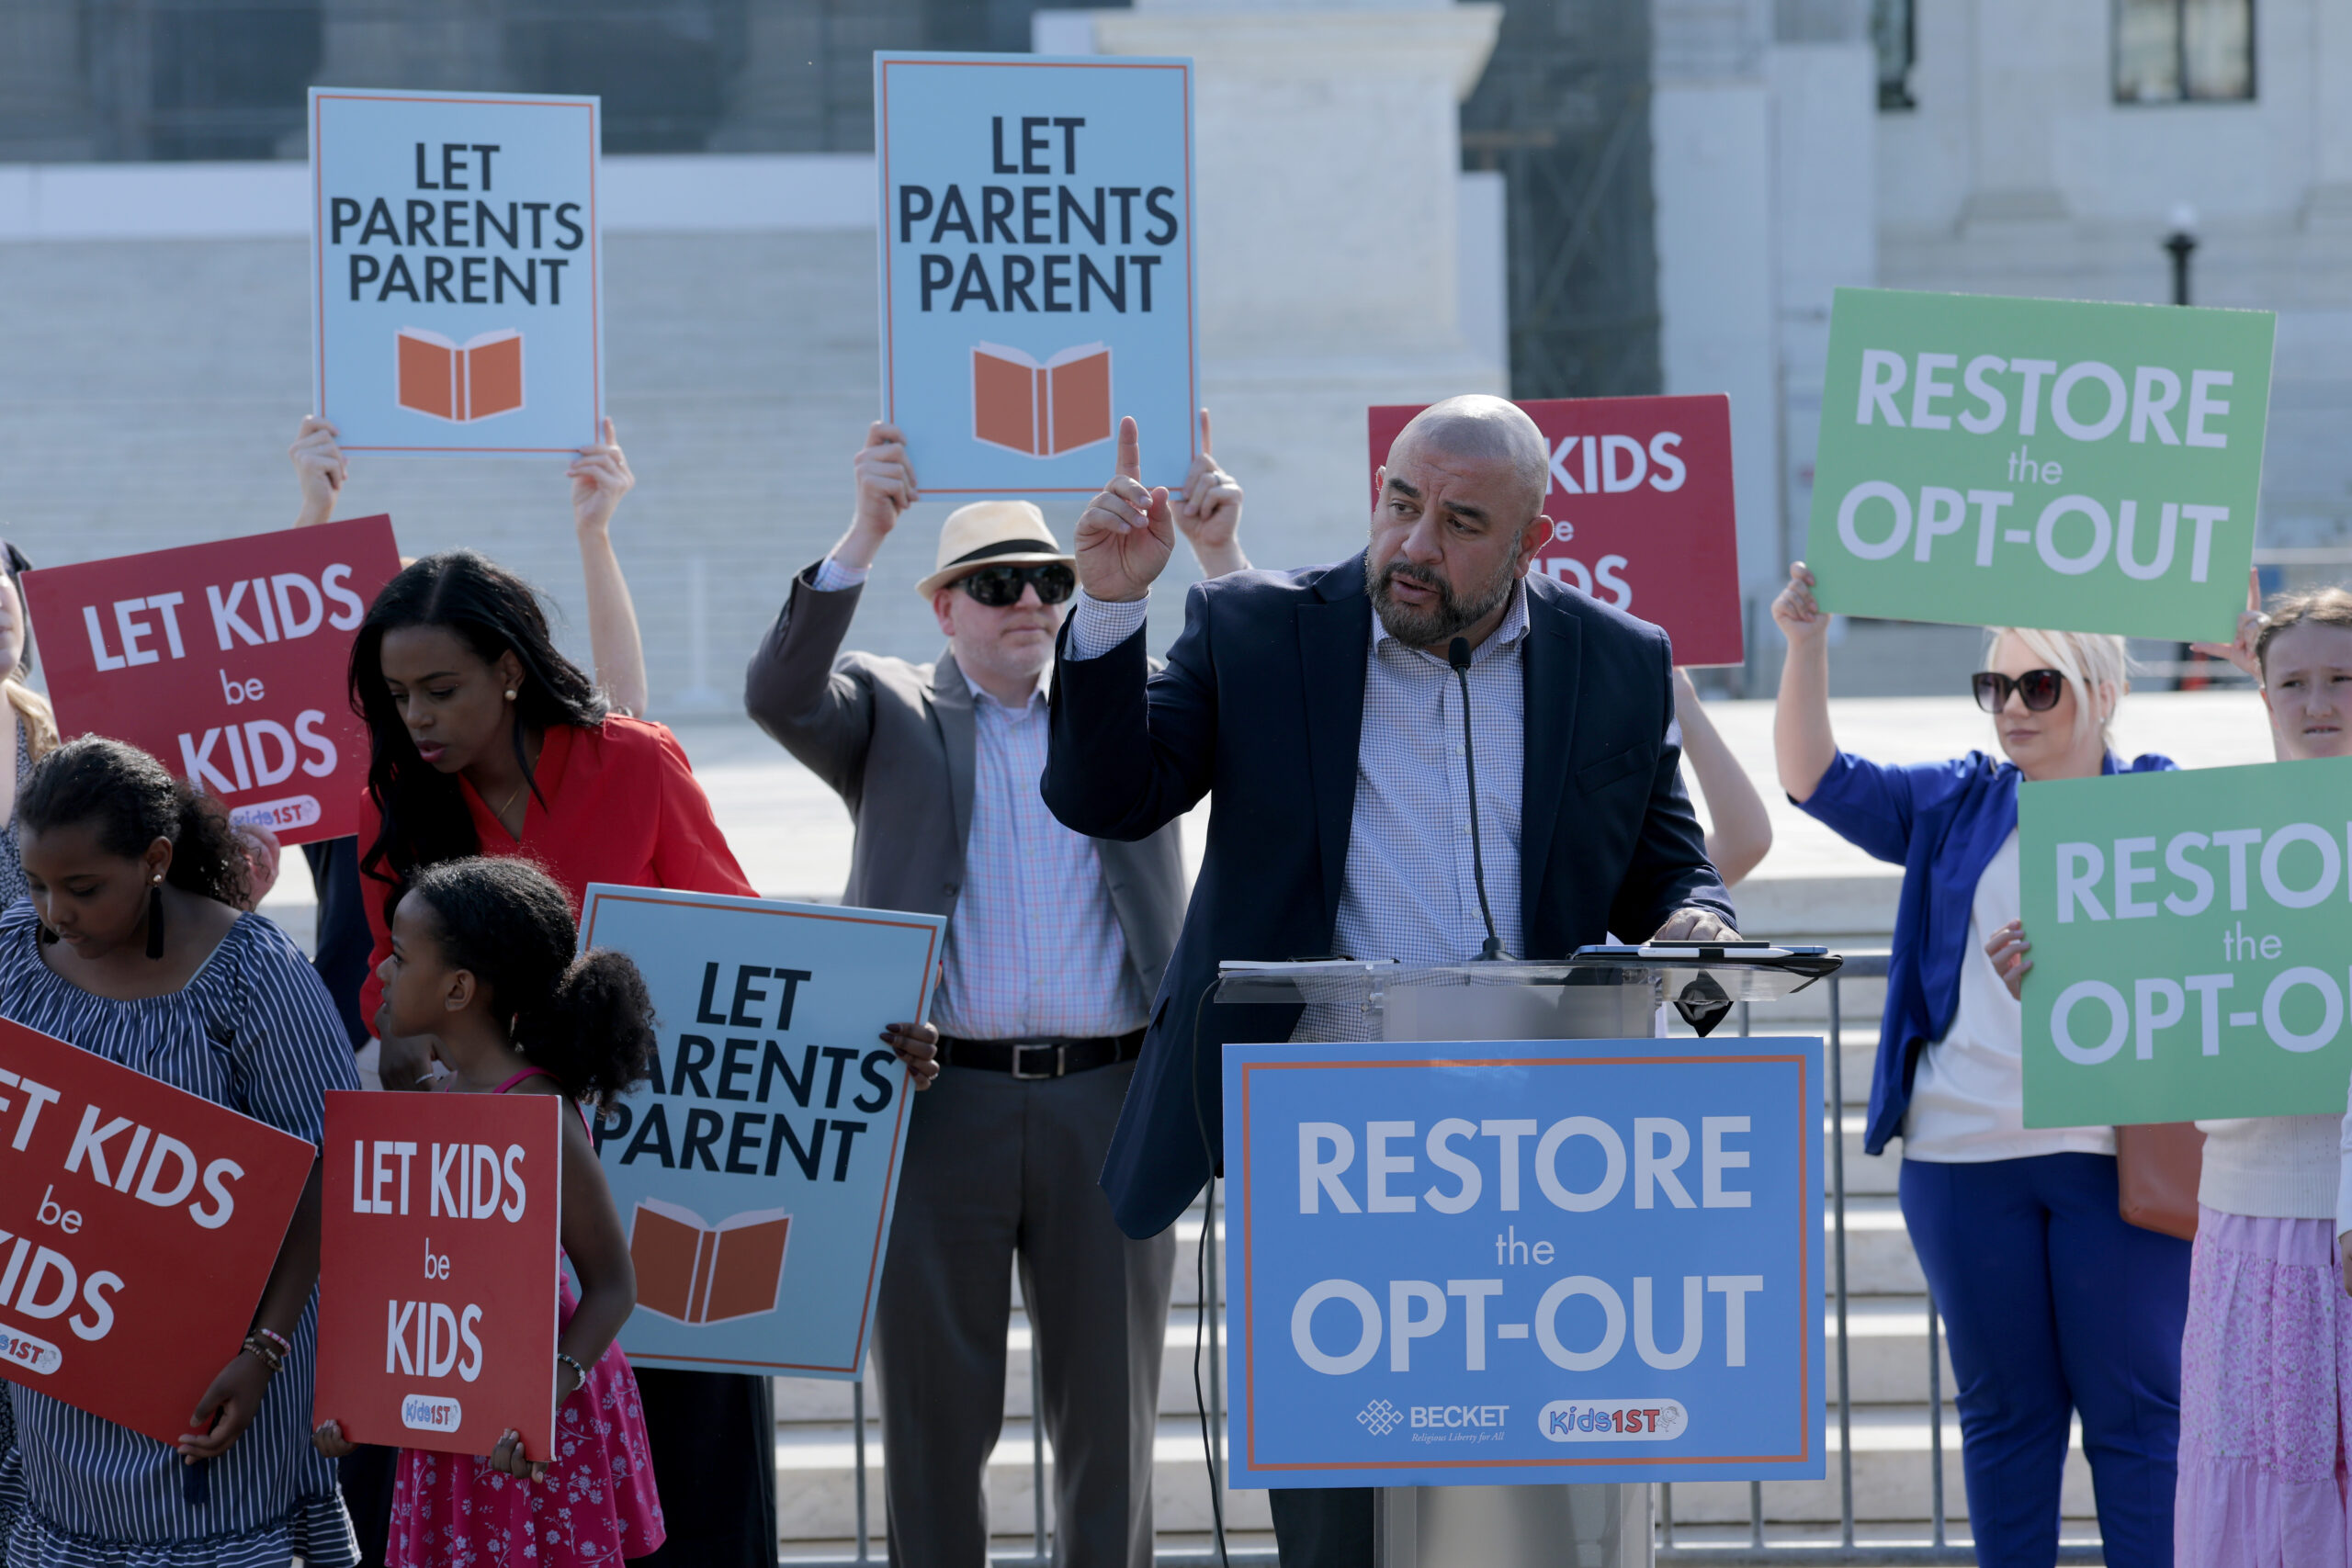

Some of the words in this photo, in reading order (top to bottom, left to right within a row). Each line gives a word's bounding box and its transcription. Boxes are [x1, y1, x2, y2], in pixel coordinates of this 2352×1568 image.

[415, 142, 501, 191] LET
[992, 117, 1086, 175] LET
[330, 196, 583, 252] PARENTS
[899, 184, 1178, 245] PARENTS
[349, 254, 569, 306] PARENT
[920, 253, 1161, 313] PARENT
[1856, 348, 2234, 448] RESTORE
[1544, 431, 1687, 495] KIDS
[2007, 445, 2063, 485] the
[1838, 480, 2230, 583] OPT-OUT
[83, 591, 186, 672] LET
[206, 562, 364, 650] KIDS
[220, 669, 265, 705] be
[177, 709, 338, 797] KIDS
[2056, 821, 2352, 923] RESTO
[2223, 920, 2283, 962] the
[696, 962, 812, 1031] LET
[2050, 965, 2352, 1066] OPT-O
[643, 1030, 897, 1114] ARENTS
[63, 1103, 245, 1229] KIDS
[593, 1103, 867, 1182] PARENT
[1298, 1115, 1752, 1214] RESTORE
[36, 1184, 83, 1234] be
[353, 1140, 417, 1215] LET
[430, 1143, 526, 1224] KIDS
[424, 1237, 450, 1280] be
[1496, 1225, 1555, 1266] the
[0, 1228, 125, 1341] IDS
[386, 1300, 483, 1382] KIDS
[1291, 1275, 1764, 1375] OPT-OUT
[1410, 1405, 1510, 1427] BECKET
[1411, 1433, 1447, 1444] Religious
[1448, 1432, 1476, 1444] Liberty
[1477, 1432, 1490, 1444] for
[1491, 1432, 1505, 1441] All
